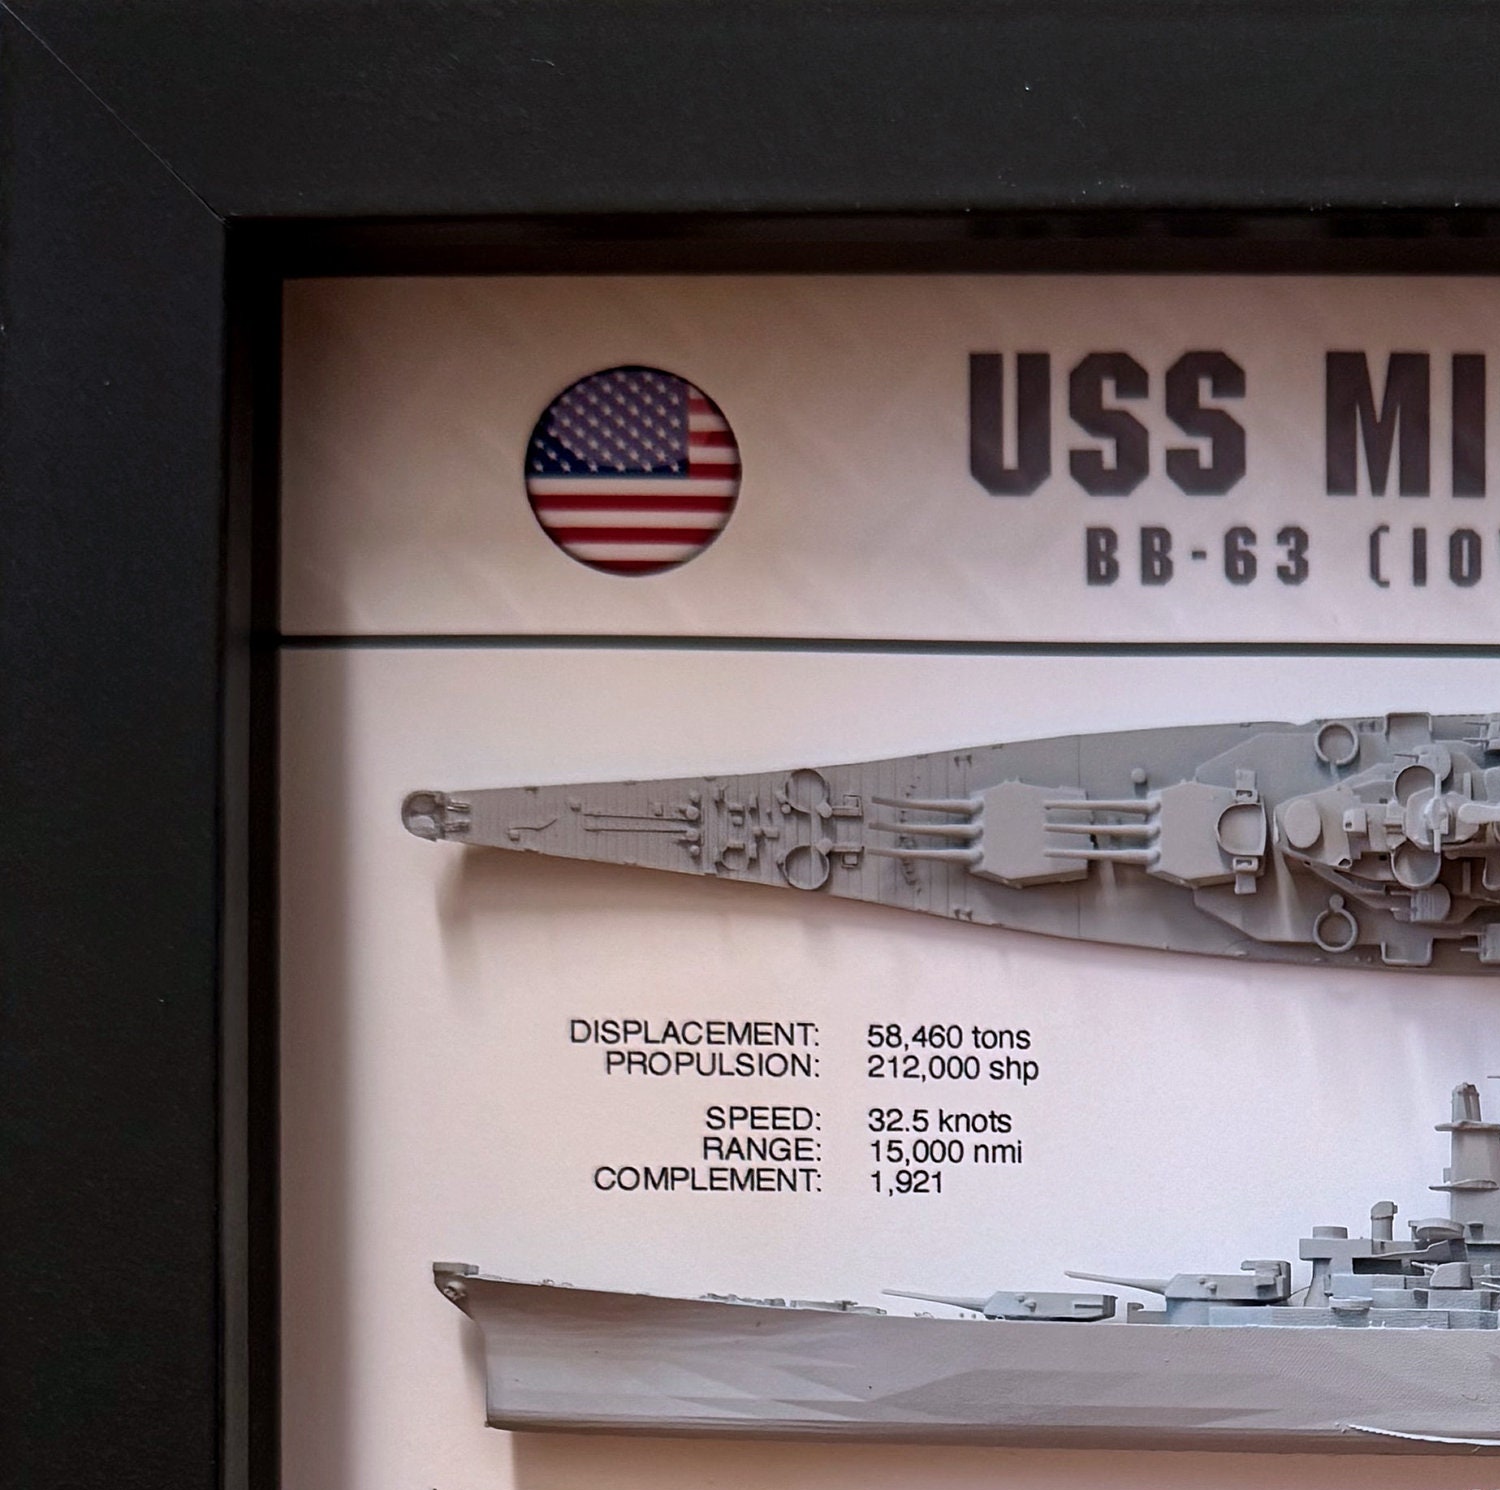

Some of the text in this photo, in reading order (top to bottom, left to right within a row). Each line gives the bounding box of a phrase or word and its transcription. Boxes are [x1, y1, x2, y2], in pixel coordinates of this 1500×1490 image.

[969, 352, 1247, 497] USS
[1084, 523, 1310, 587] BB-63
[570, 1019, 1032, 1052] DISPLACEMENT: 58,460 tons
[606, 1050, 1040, 1087] PROPULSION: 212,000 shp
[705, 1105, 1013, 1134] SPEED: 32.5 knots
[702, 1135, 1023, 1167] RANGE: 15,000 nmi
[593, 1165, 942, 1197] COMPLEMENT: 1,921
